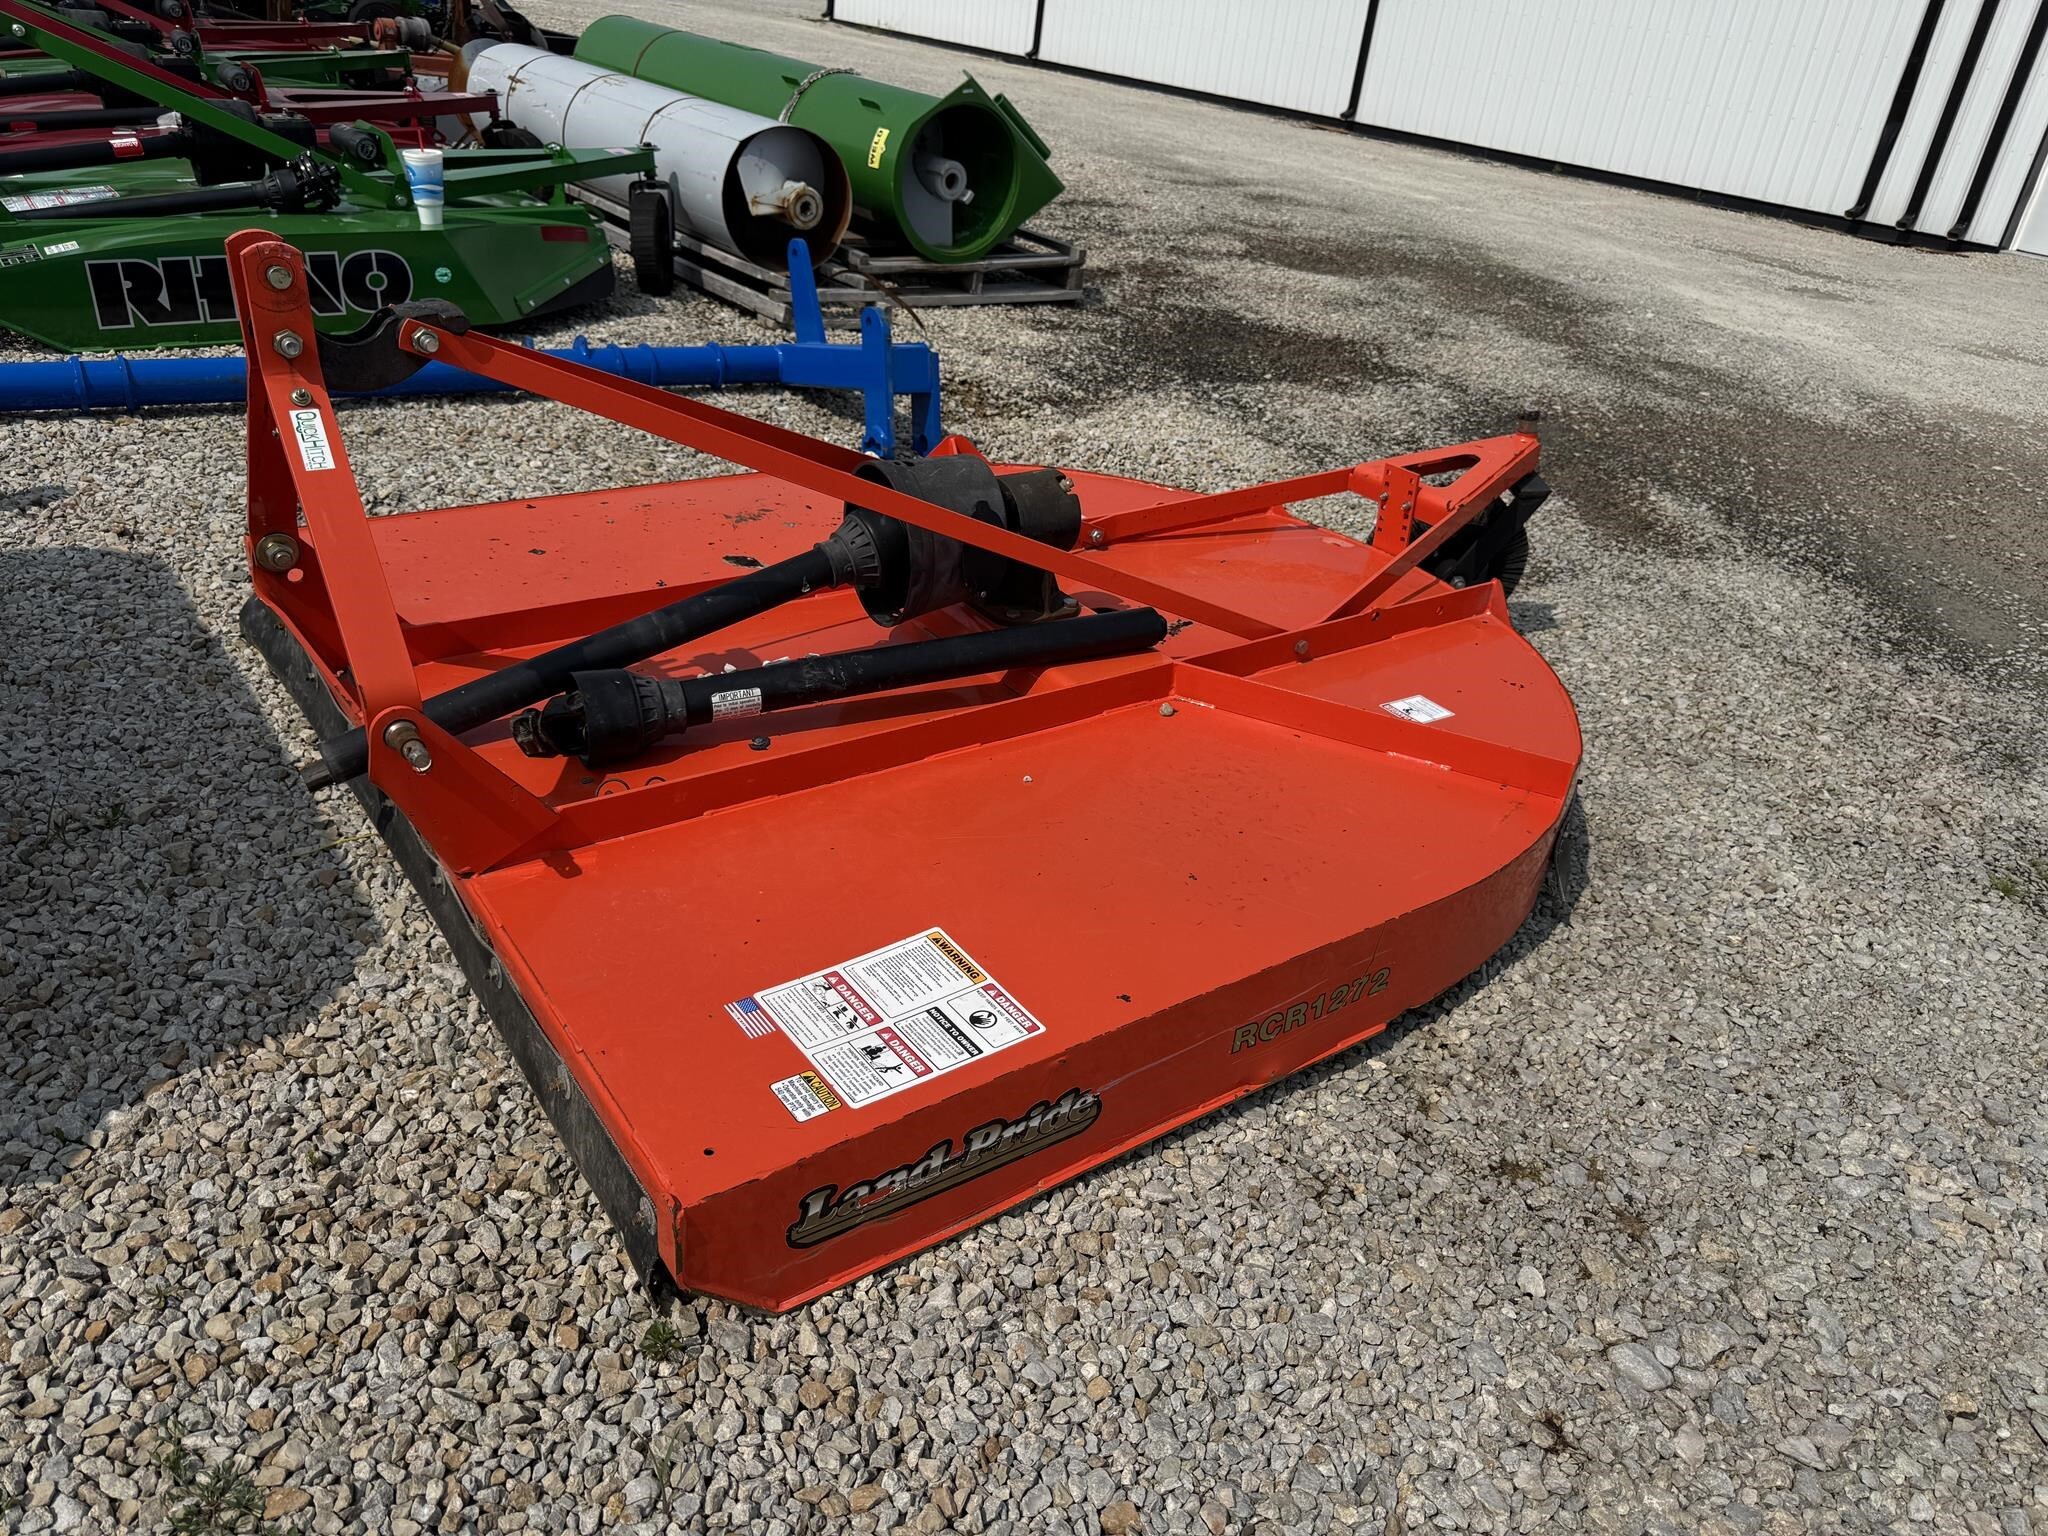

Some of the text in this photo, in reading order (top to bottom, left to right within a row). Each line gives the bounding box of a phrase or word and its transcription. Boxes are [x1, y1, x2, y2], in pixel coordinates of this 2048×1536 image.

[85, 249, 413, 330] RHNO
[718, 689, 755, 701] IMPORTANT
[939, 939, 980, 980] WARNING
[836, 984, 874, 1021] DANGER
[995, 996, 1032, 1028] DANGER
[1231, 967, 1391, 1054] RCR1272
[930, 1009, 979, 1055] NOTICE TO OWNER
[889, 1040, 925, 1072] DANGER
[788, 1080, 803, 1095] Machine
[799, 1083, 811, 1093] avoid
[810, 1081, 839, 1107] CAUTION
[799, 1087, 1103, 1233] Land Pride
